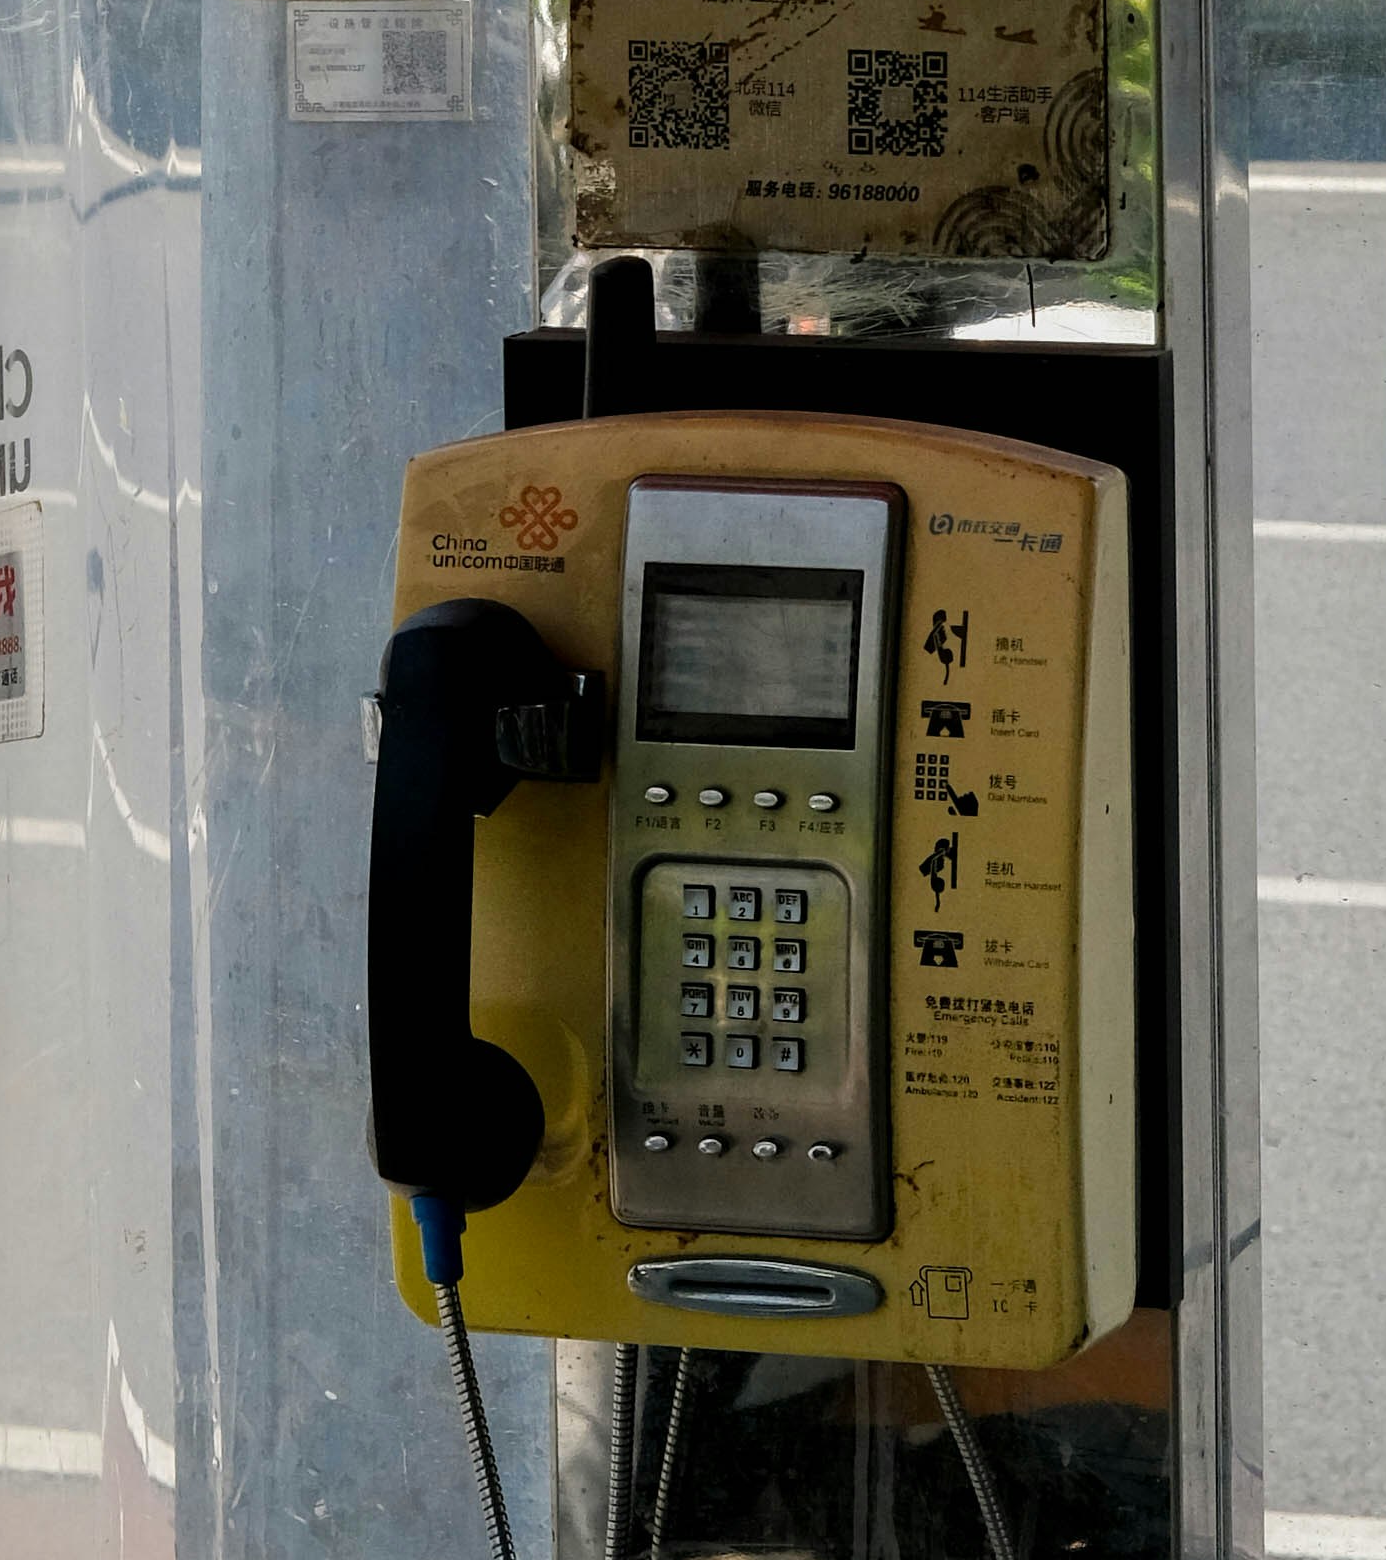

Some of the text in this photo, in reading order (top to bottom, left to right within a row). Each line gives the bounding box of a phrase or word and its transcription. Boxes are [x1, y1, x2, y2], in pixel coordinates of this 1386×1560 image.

[734, 77, 795, 97] 北京114
[958, 84, 1053, 104] 114生活助手
[749, 99, 782, 117] 微信
[980, 105, 1030, 124] 客户端
[827, 183, 920, 202] 96188000
[431, 533, 488, 552] China
[993, 532, 1064, 554] 一卡通
[996, 637, 1024, 652] 摘机
[991, 708, 1021, 724] 插卡
[989, 726, 1040, 738] Insert Card
[988, 774, 1018, 790] 拨号
[987, 792, 1049, 805] Dial Numbers
[705, 817, 722, 831] F2
[759, 818, 777, 832] F3
[985, 860, 1015, 876] 挂机
[732, 892, 753, 903] ABC
[778, 894, 799, 905] DEF
[686, 939, 706, 951] GHI
[733, 941, 752, 953] JKL
[983, 957, 1051, 969] Withdraw Card
[732, 990, 752, 1001] TUV
[925, 995, 1035, 1016] 免费拨打紧急电话
[933, 1010, 1030, 1027] Emergency Calls
[735, 1046, 745, 1058] 0
[698, 1104, 726, 1118] 音量
[990, 1279, 1038, 1294] 一卡通
[992, 1299, 1038, 1316] IC 卡
